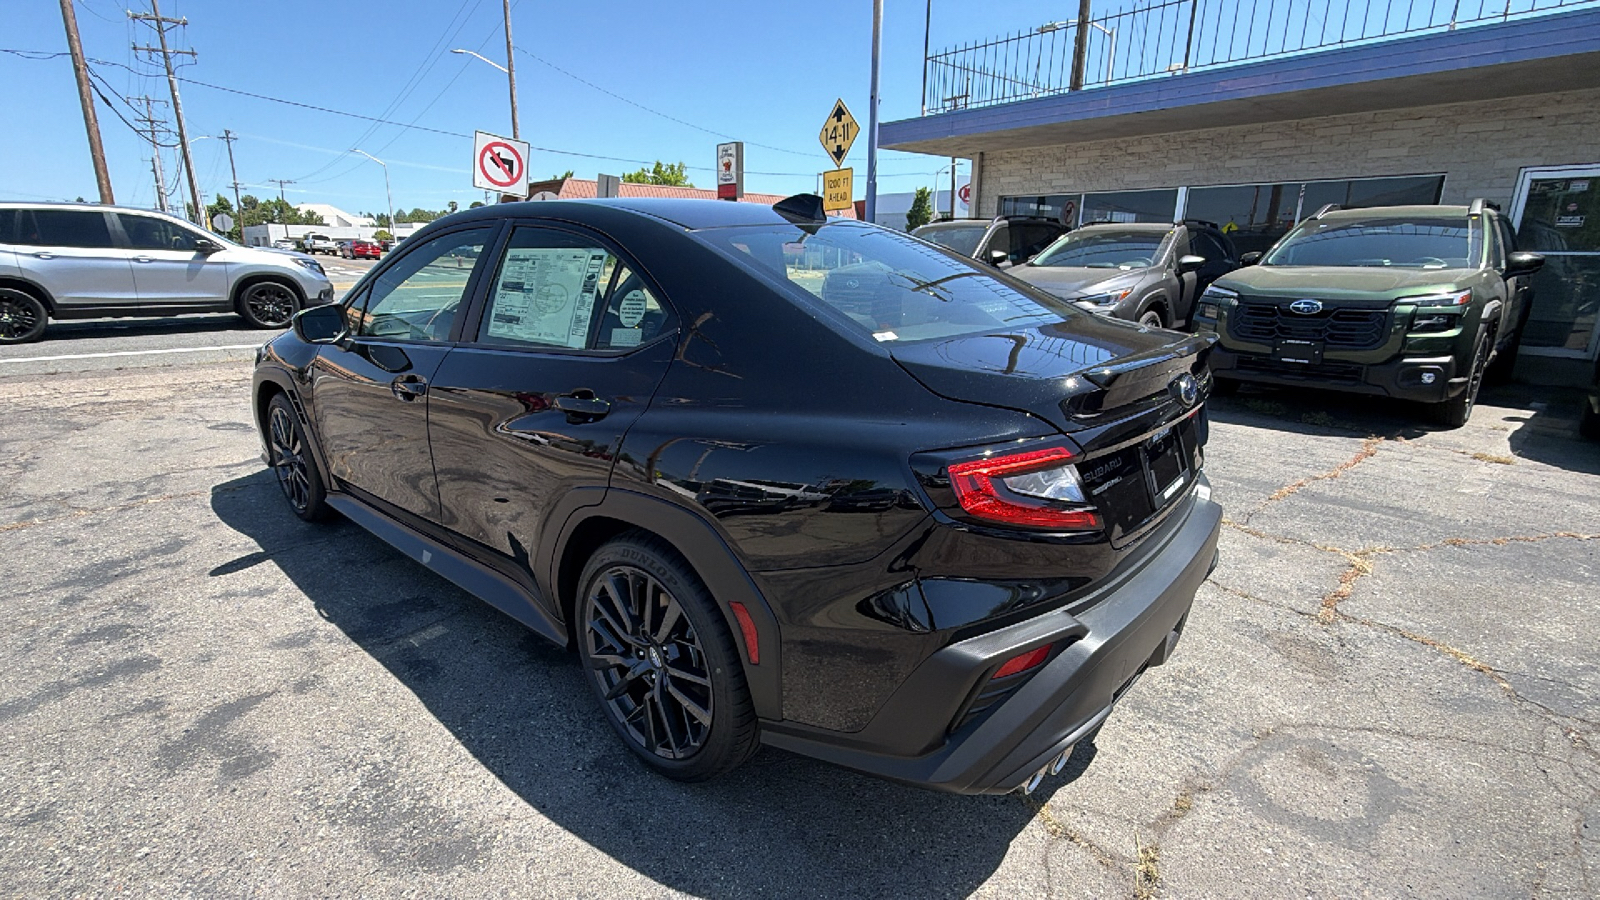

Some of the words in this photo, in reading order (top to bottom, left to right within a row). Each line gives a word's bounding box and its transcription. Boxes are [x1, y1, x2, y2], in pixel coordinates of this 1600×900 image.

[828, 178, 841, 188] 1200
[843, 177, 849, 187] FT
[829, 192, 848, 202] AHEAD
[1083, 456, 1123, 483] SUBARU
[621, 549, 679, 586] DUNLOP
